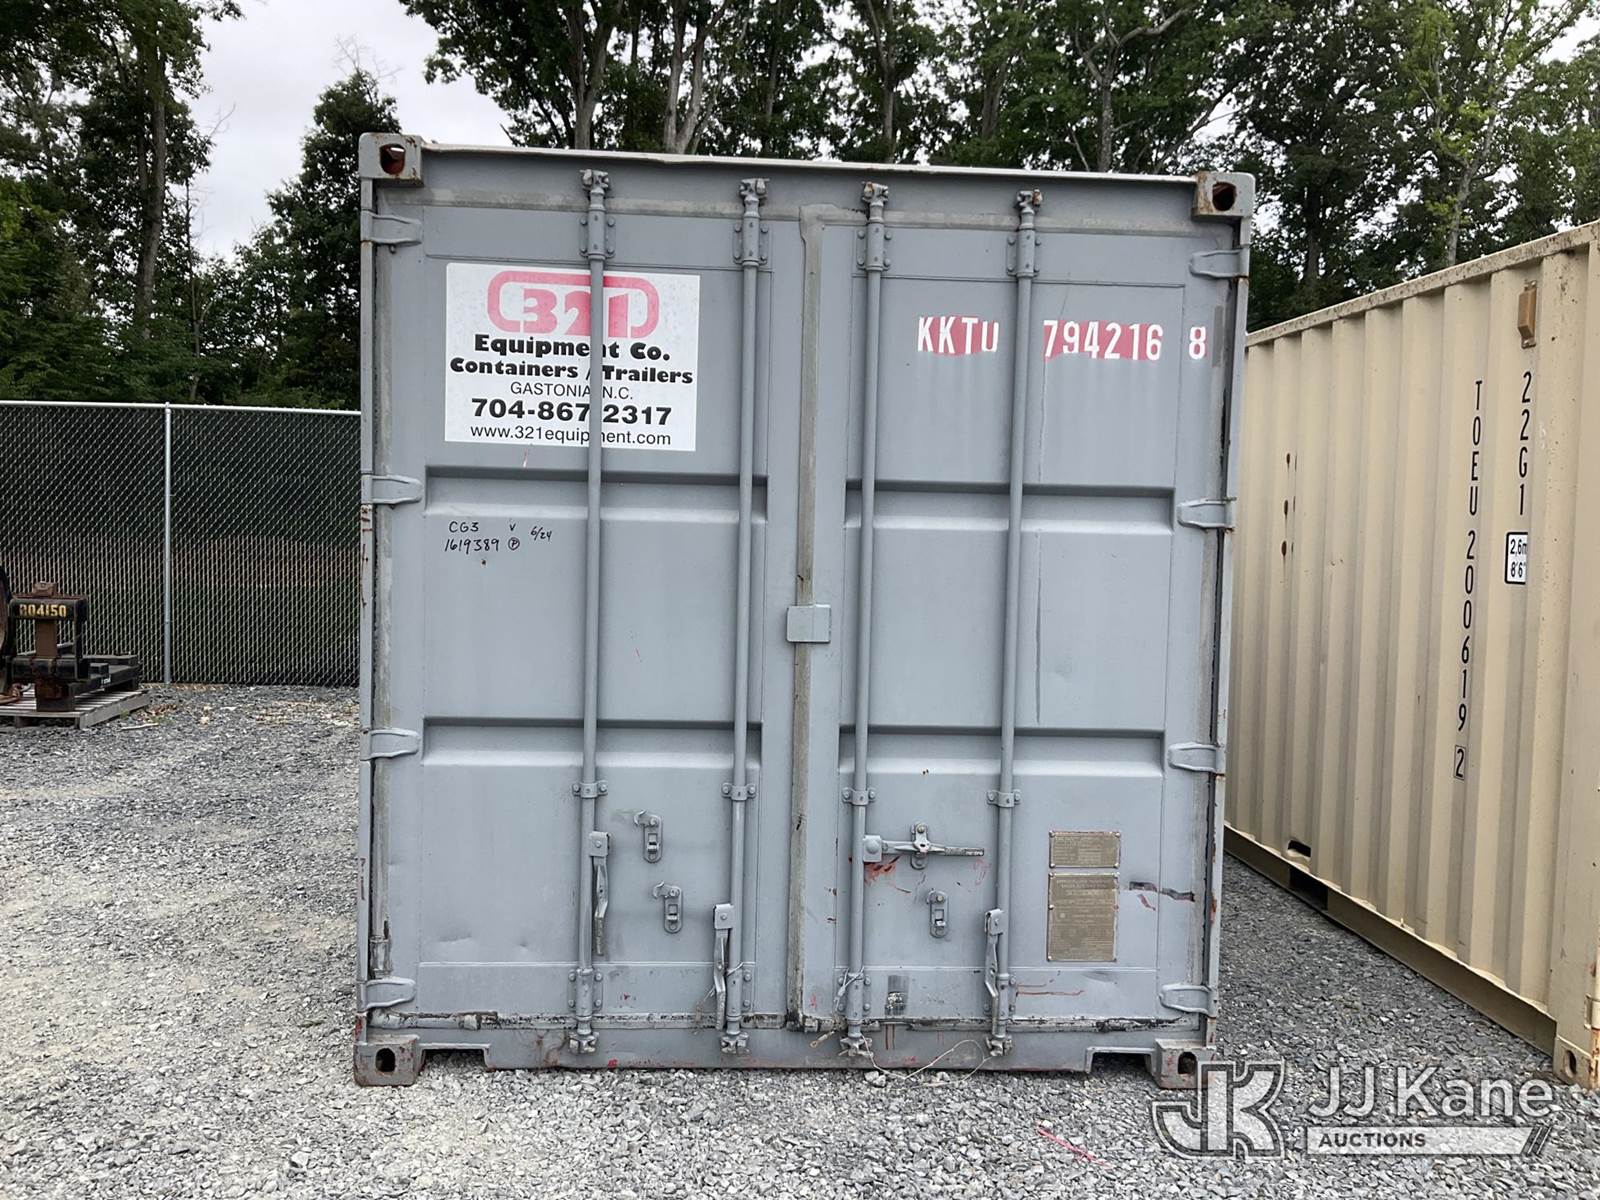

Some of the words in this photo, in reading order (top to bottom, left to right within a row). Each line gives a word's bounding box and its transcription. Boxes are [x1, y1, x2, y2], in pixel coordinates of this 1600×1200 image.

[474, 334, 620, 359] Equipmet
[630, 341, 670, 361] Co.
[917, 316, 999, 354] KKTU
[1043, 319, 1163, 361] 794216
[1188, 326, 1206, 360] 8
[450, 357, 579, 379] Containers
[602, 365, 693, 384] Trailers
[602, 385, 633, 400] N.C.
[472, 398, 672, 426] 704-8672317
[470, 425, 671, 446] www.321equipent.com
[1468, 380, 1483, 516] TOEU
[1517, 371, 1532, 516] 22G1
[448, 521, 479, 533] CG3
[444, 538, 499, 555] 1619389
[1457, 530, 1477, 732] 200619
[1456, 748, 1465, 778] 2
